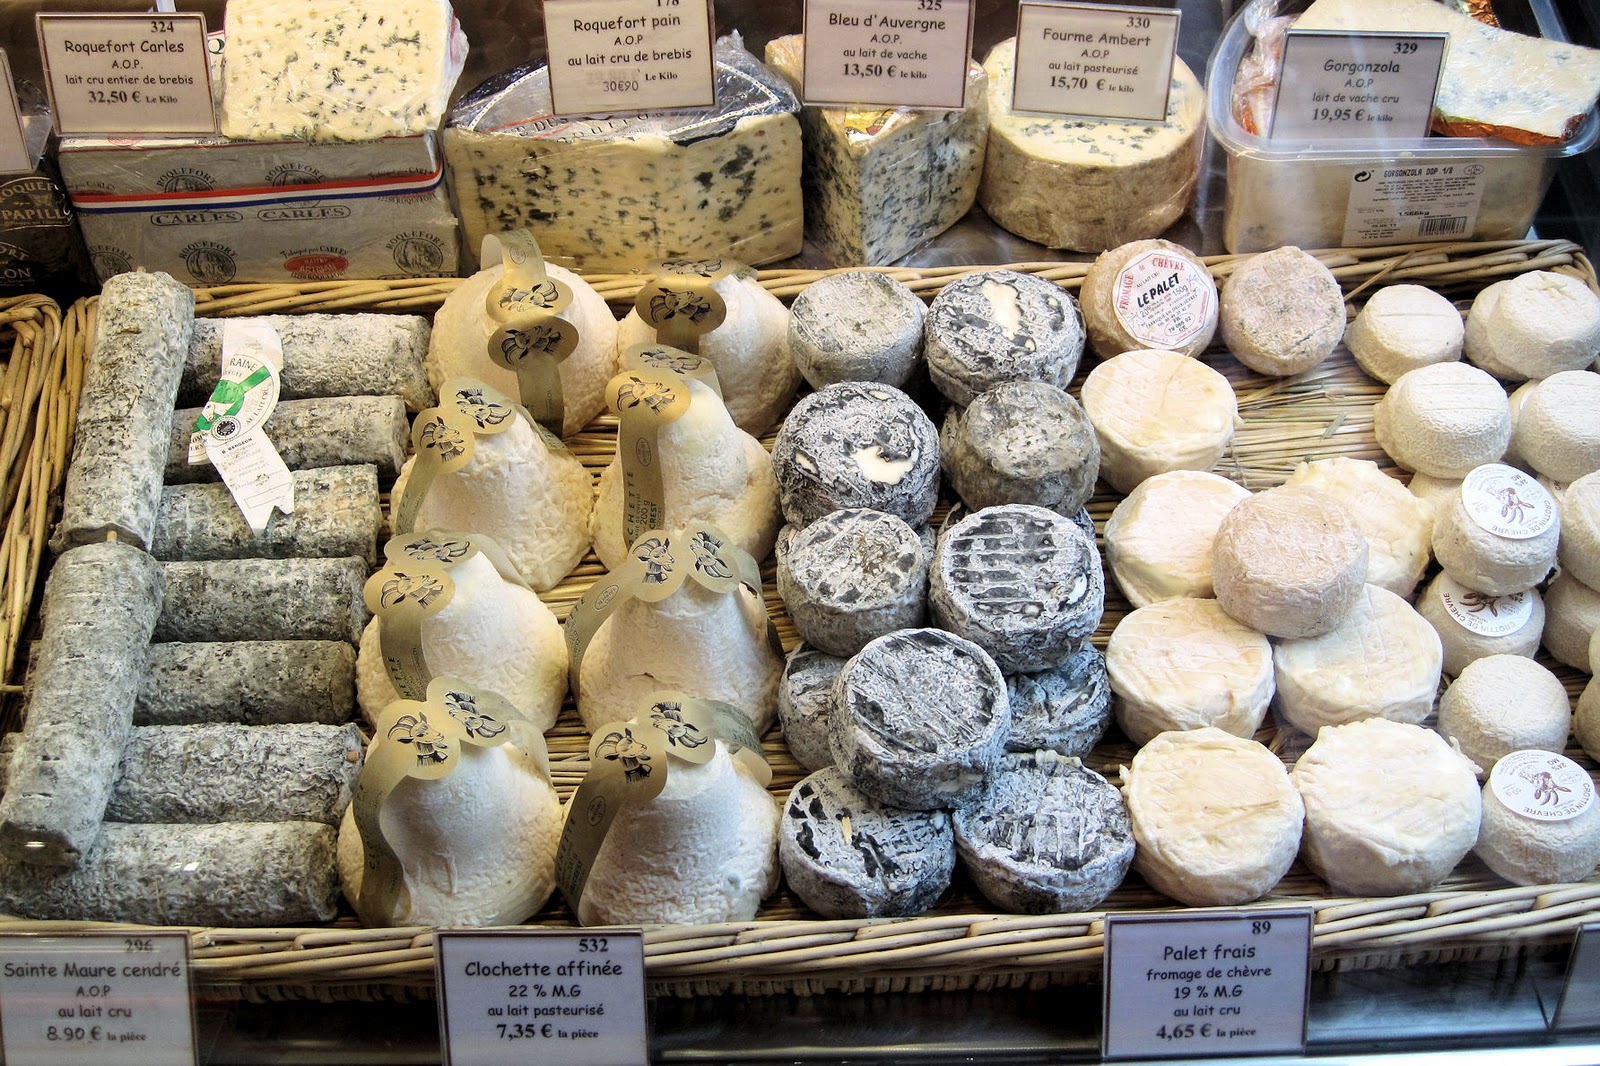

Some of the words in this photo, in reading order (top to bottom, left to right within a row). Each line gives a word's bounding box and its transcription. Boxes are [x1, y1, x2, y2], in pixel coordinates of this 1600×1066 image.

[917, 0, 942, 11] 325
[574, 16, 646, 34] Roquefort
[652, 15, 681, 30] pain
[829, 13, 859, 26] Bleu
[1126, 16, 1150, 29] 330
[150, 21, 174, 33] 324
[614, 35, 644, 46] A.O.P
[870, 34, 902, 44] A.O.P.
[1043, 28, 1094, 43] Fourme
[1098, 33, 1152, 47] Ambert
[64, 40, 135, 56] Roquefort
[140, 40, 185, 53] Carles
[858, 48, 877, 58] lait
[880, 49, 893, 58] de
[897, 51, 928, 60] vache
[1081, 49, 1110, 58] A.O.P
[1393, 42, 1418, 55] 329
[568, 57, 582, 66] au
[585, 54, 606, 65] lait
[610, 54, 630, 63] cru
[634, 51, 649, 62] de
[652, 48, 692, 60] brebis
[111, 59, 144, 70] A.O.P.
[843, 64, 883, 78] 13,50
[887, 65, 897, 78] €
[910, 71, 927, 79] kilo
[1048, 61, 1061, 70] au
[1063, 61, 1080, 71] lait
[1083, 63, 1138, 75] pasteurisé
[1323, 58, 1400, 75] Gorgonzola
[65, 75, 83, 84] lait
[107, 75, 139, 85] entier
[143, 75, 156, 85] de
[159, 75, 194, 85] brebis
[645, 73, 657, 81] Le
[659, 72, 678, 80] Kilo
[1343, 78, 1375, 88] A.O.P
[1049, 75, 1088, 90] 15,70
[1096, 79, 1106, 91] €
[1108, 84, 1116, 92] le
[1118, 84, 1134, 93] kilo
[87, 91, 128, 104] 32,50
[131, 91, 141, 103] €
[159, 96, 178, 104] Kilo
[1312, 92, 1331, 102] lait
[1333, 92, 1346, 103] de
[1349, 93, 1380, 103] vache
[1381, 95, 1400, 104] cru
[1312, 108, 1352, 122] 19,95
[1354, 108, 1365, 121] €
[1376, 114, 1393, 122] kilo
[156, 168, 217, 187] ROQUEFORT
[264, 163, 324, 182] ROQUEFORT
[1383, 168, 1423, 178] GORGONZOLA
[2, 209, 66, 220] PAPILL
[156, 213, 239, 224] CARLES
[262, 207, 345, 219] CARLES
[386, 230, 446, 250] ROQUEFORT
[179, 240, 238, 259] ROQUEFORT
[1119, 274, 1134, 311] FROMAGE
[1152, 257, 1185, 271] CHÈVRE
[1137, 292, 1150, 308] LE
[1149, 272, 1180, 300] PALET
[627, 471, 635, 546] OCHETTE
[640, 508, 649, 525] 200
[1491, 525, 1528, 536] CHEVRE
[1443, 593, 1466, 621] CHEVRE
[1467, 619, 1478, 630] DE
[1577, 782, 1591, 811] CROTTIN
[1523, 806, 1563, 817] CHEVRE
[1252, 921, 1271, 935] 89
[578, 937, 609, 953] 532
[1163, 946, 1207, 961] Palet
[1213, 944, 1256, 960] frais
[4, 962, 58, 978] Sainte
[64, 963, 117, 978] Maure
[122, 962, 182, 977] cendré
[465, 961, 550, 977] Clochette
[556, 960, 623, 976] affinée
[1146, 969, 1202, 982] fromage
[1206, 967, 1222, 979] de
[1227, 965, 1272, 978] chèvre
[76, 985, 111, 997] A.O.P
[509, 984, 528, 998] 22
[533, 984, 547, 997] %
[552, 984, 581, 998] M.G
[1174, 986, 1191, 999] 19
[1196, 986, 1209, 998] %
[1214, 984, 1243, 998] M.G
[58, 1007, 74, 1017] au
[79, 1005, 103, 1017] lait
[108, 1007, 132, 1017] cru
[487, 1007, 503, 1016] au
[507, 1005, 529, 1016] lait
[534, 1004, 605, 1019] pasteurisé
[1173, 1008, 1188, 1017] au
[1193, 1005, 1214, 1016] lait
[1219, 1006, 1241, 1015] cru
[47, 1026, 85, 1041] 8.90
[90, 1026, 102, 1041] €
[106, 1032, 118, 1041] la
[120, 1032, 147, 1042] pièce
[496, 1023, 536, 1041] 7,35
[541, 1023, 553, 1039] €
[557, 1029, 568, 1038] la
[571, 1029, 599, 1040] pièce
[1155, 1024, 1195, 1042] 4,65
[1200, 1023, 1212, 1038] €
[1216, 1028, 1226, 1037] la
[1229, 1027, 1256, 1039] pièce
